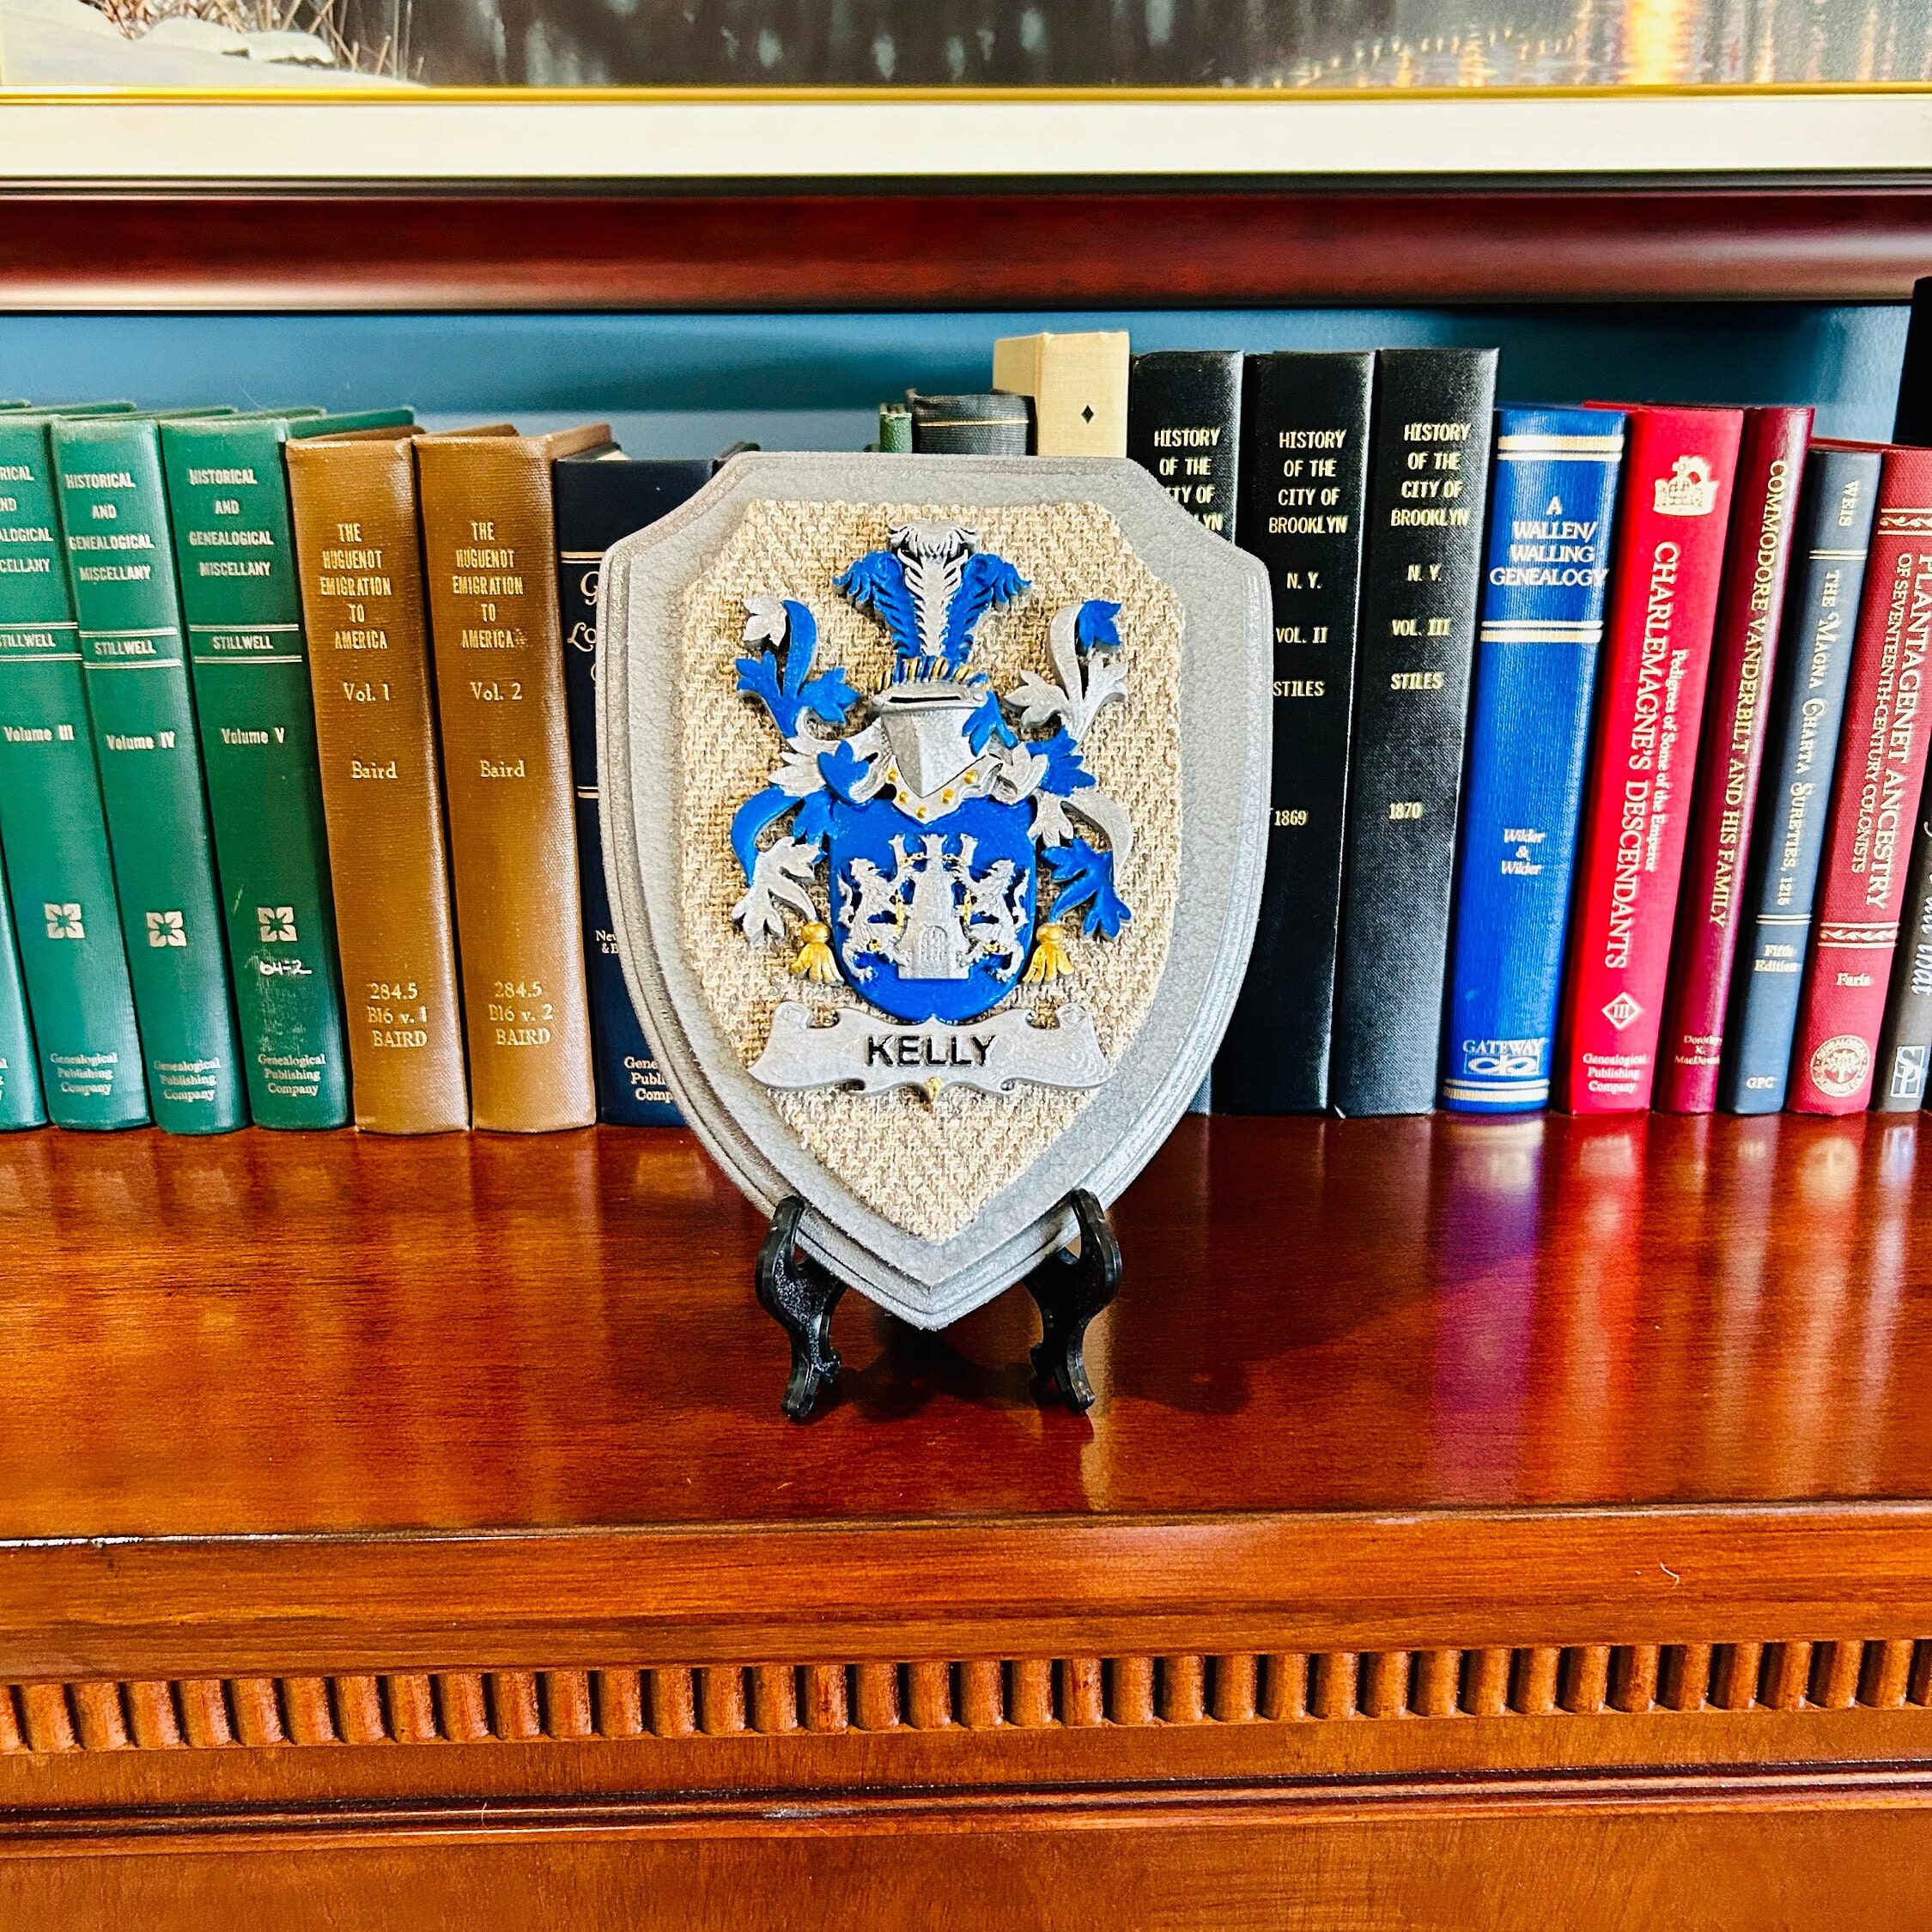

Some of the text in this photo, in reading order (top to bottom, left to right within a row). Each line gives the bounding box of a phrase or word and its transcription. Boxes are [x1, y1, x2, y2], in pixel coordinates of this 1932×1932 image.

[1154, 427, 1220, 447] HISTORY
[1279, 429, 1346, 448] HISTORY
[1404, 422, 1471, 442] HISTORY
[1159, 456, 1212, 476] OF THE
[1284, 459, 1336, 477] OF THE
[1407, 452, 1461, 470] OF THE
[65, 472, 136, 489] HISTORICAL
[189, 469, 258, 485] HISTORICAL
[1196, 484, 1215, 504] OF
[1278, 488, 1340, 506] CITY OF
[1401, 480, 1462, 498] CITY OF
[92, 505, 117, 519] AND
[215, 500, 240, 514] AND
[1546, 496, 1563, 515] A
[1838, 480, 1860, 526] WEIS
[1269, 516, 1348, 534] BROOKLYN
[1391, 508, 1469, 526] BROOKLYN
[189, 531, 274, 545] GENEALOGICAL
[337, 523, 362, 543] THE
[471, 522, 495, 541] THE
[1512, 521, 1597, 543] WALLEN/
[70, 534, 155, 550] GENEALOGICAL
[322, 550, 382, 569] HUGUENOT
[455, 548, 514, 568] HUGUENOT
[1510, 545, 1595, 562] WALLING
[80, 565, 150, 581] MISCELLANY
[199, 562, 270, 576] MISCELLANY
[1897, 552, 1912, 578] OF
[319, 576, 392, 596] EMIGRATION
[453, 575, 523, 595] EMIGRATION
[1287, 572, 1321, 589] N. Y.
[1490, 568, 1609, 586] GENEALOGY
[1822, 569, 1840, 608] THE
[349, 604, 365, 623] TO
[481, 603, 496, 622] TO
[1276, 626, 1328, 643] VOL. II
[1392, 618, 1451, 636] VOL. III
[94, 640, 156, 655] STILLWELL
[213, 635, 274, 650] STILLWELL
[335, 630, 387, 650] AMERICA
[462, 630, 514, 648] AMERICA
[1273, 681, 1325, 696] STILES
[1390, 671, 1444, 690] STILES
[343, 683, 376, 702] Vol.
[470, 682, 523, 701] Vol. 2
[1710, 460, 1788, 928] COMMODORE VANDERBILT AND HIS FAMILY
[4, 725, 75, 742] Volume III
[106, 732, 175, 750] Volume IV
[222, 727, 285, 744] Volume V
[1605, 541, 1681, 969] CHARLEMAGNE'S DESCENDANTS
[1645, 648, 1689, 873] Pedigrees of Some of the Emperor
[350, 761, 398, 779] Baird
[480, 760, 525, 778] Baird
[1274, 810, 1308, 825] 1869
[1388, 802, 1424, 819] 1870
[1504, 829, 1546, 844] Wilder
[1850, 784, 1877, 874] COLONISTS
[1866, 768, 1908, 910] ANCESTRY
[1516, 846, 1531, 861] &
[1502, 861, 1544, 876] Wilder
[369, 982, 418, 1000] 284.5
[495, 981, 543, 998] 284.5
[542, 1003, 554, 1020] 2
[373, 1030, 428, 1048] BAIRD
[495, 1028, 550, 1046] BAIRD
[1462, 1037, 1549, 1054] GATEWAY
[50, 1053, 118, 1066] Genealogical
[866, 1035, 998, 1067] KELLY
[1583, 1053, 1646, 1067] Genealogical
[154, 1056, 222, 1073] Genealogical
[258, 1054, 325, 1068] Genealogical
[58, 1067, 113, 1080] Publishing
[159, 1074, 217, 1086] Publishing
[264, 1068, 320, 1082] Publishing
[1588, 1067, 1641, 1080] Publishing
[61, 1081, 112, 1096] Company
[164, 1089, 215, 1103] Company
[267, 1082, 319, 1097] Company
[635, 1087, 673, 1103] Comp
[1589, 1080, 1636, 1095] Company
